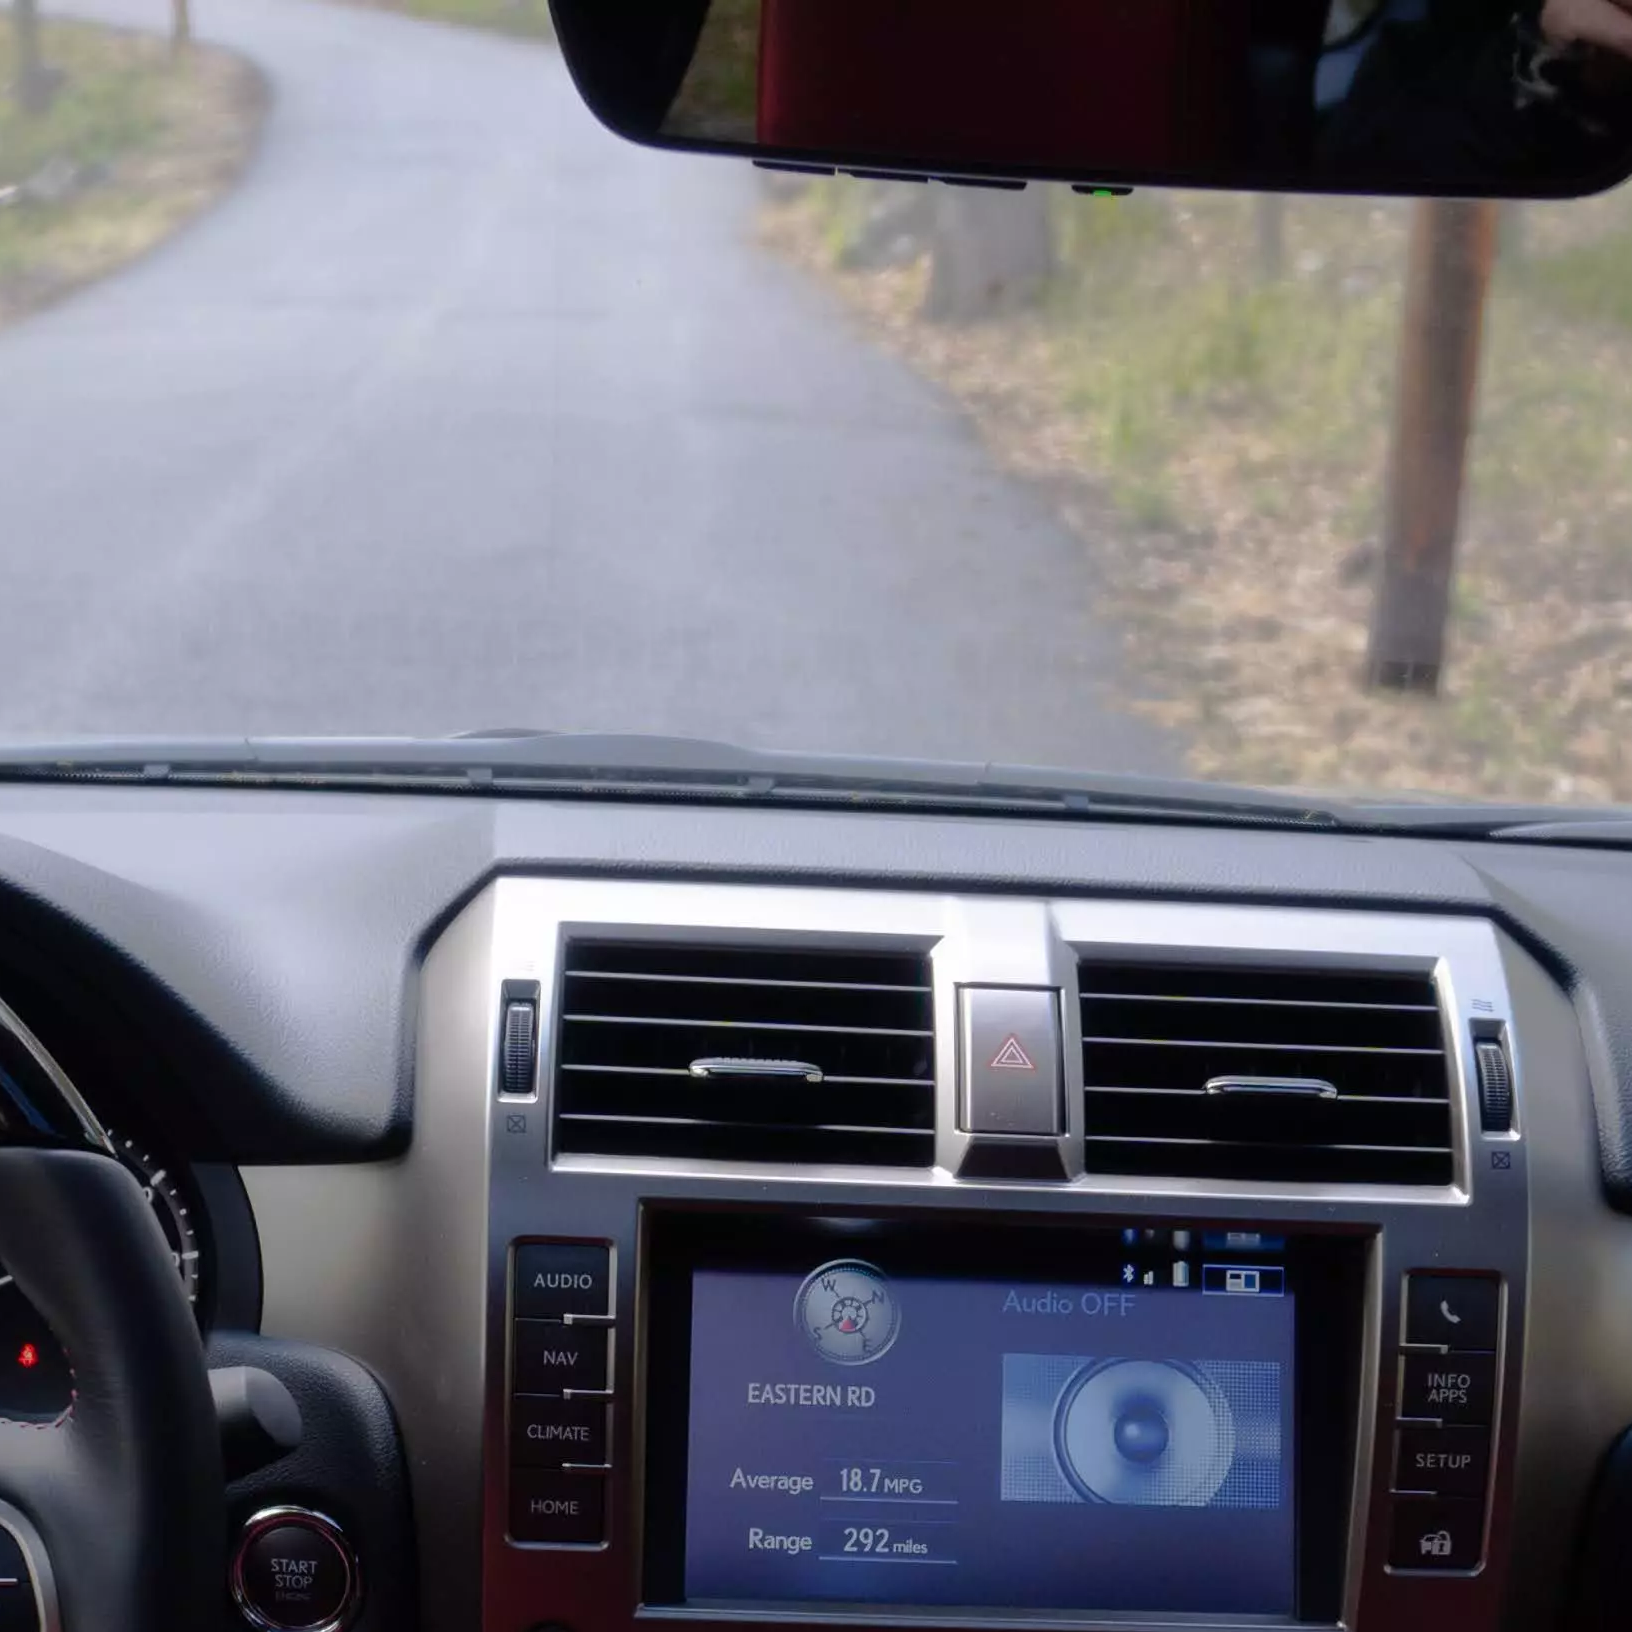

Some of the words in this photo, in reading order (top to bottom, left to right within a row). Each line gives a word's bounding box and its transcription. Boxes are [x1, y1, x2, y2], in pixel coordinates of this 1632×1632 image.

[534, 1274, 592, 1289] AUDIO
[1003, 1290, 1073, 1313] Audio
[1081, 1293, 1135, 1316] OFF
[544, 1351, 578, 1365] NAV
[1427, 1372, 1471, 1390] INFO
[748, 1383, 841, 1406] EASTERN
[848, 1386, 875, 1406] RD
[1427, 1389, 1468, 1404] APPS
[527, 1424, 589, 1440] CLIMATE
[1416, 1454, 1470, 1468] SETUP
[730, 1468, 813, 1494] Average
[841, 1469, 881, 1492] 18.7
[884, 1478, 922, 1493] MPG
[531, 1500, 578, 1514] HOME
[749, 1528, 812, 1554] Range
[844, 1528, 889, 1552] 292
[893, 1539, 927, 1553] miles
[270, 1558, 319, 1575] START
[274, 1574, 314, 1589] STOP
